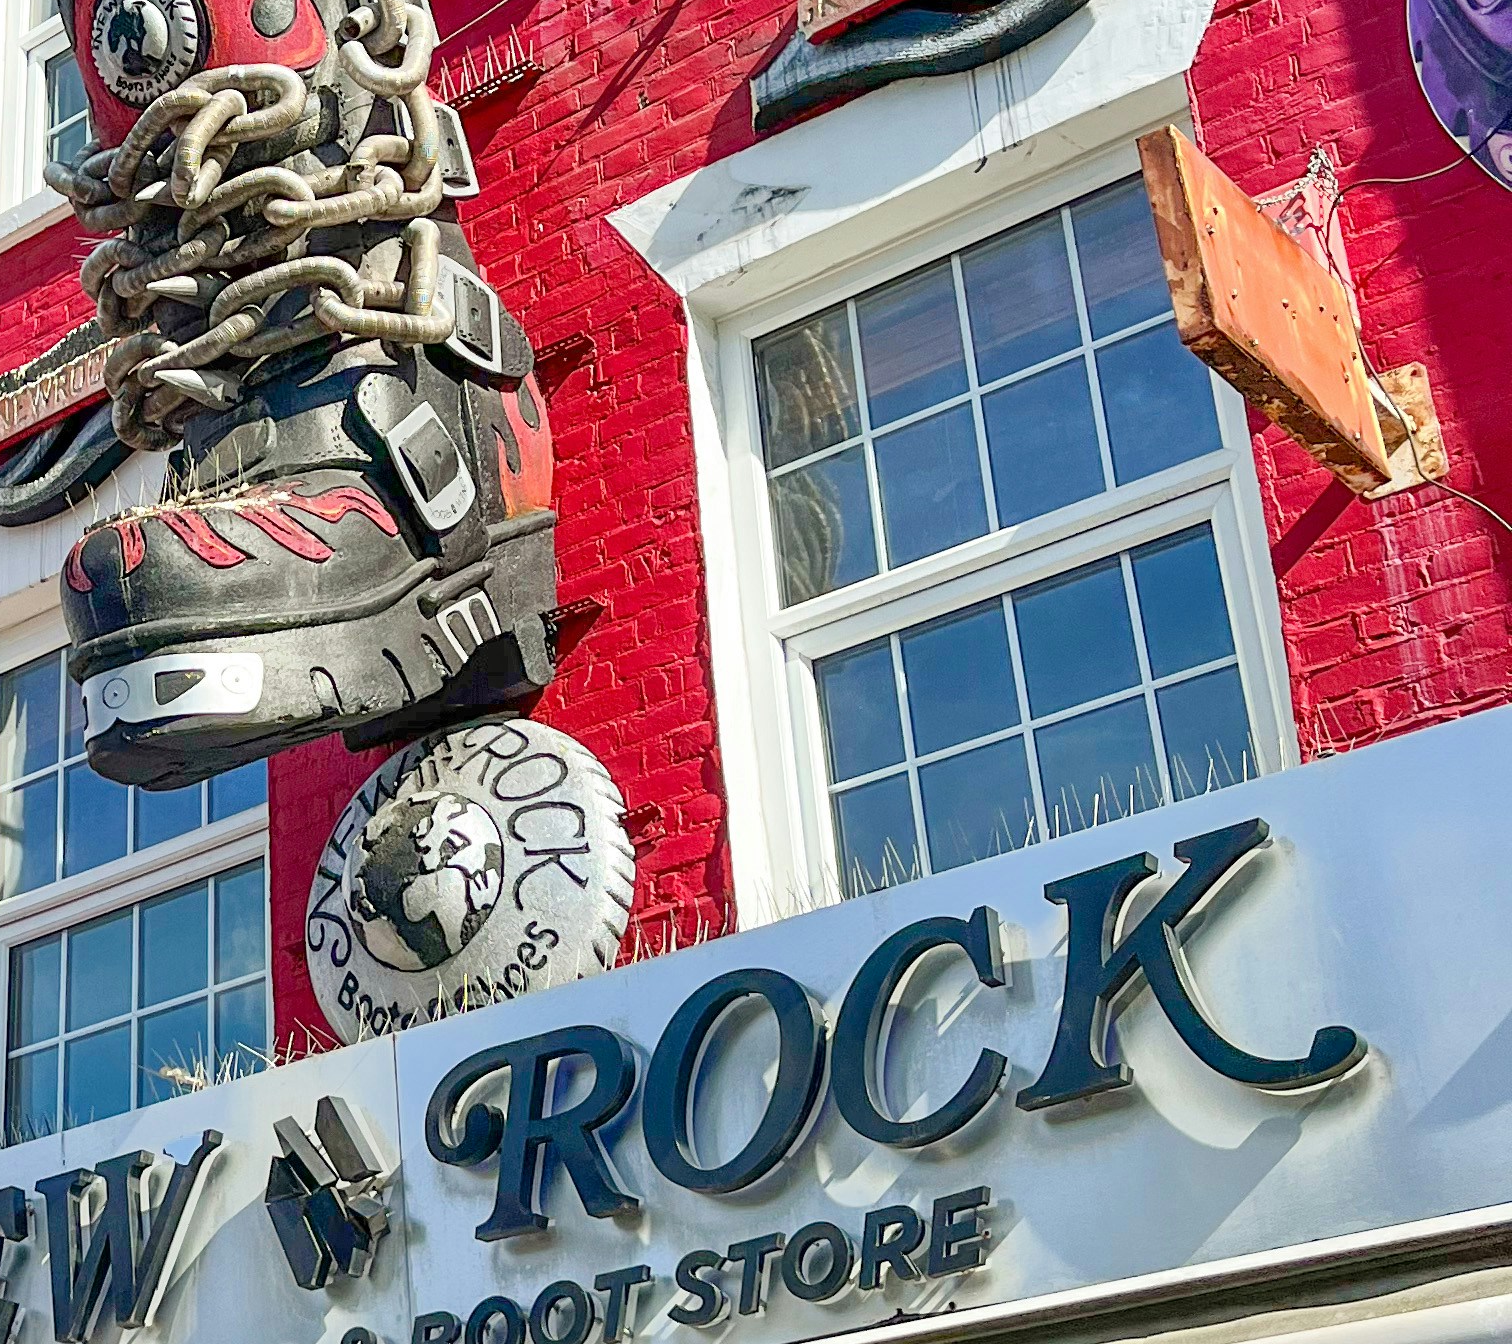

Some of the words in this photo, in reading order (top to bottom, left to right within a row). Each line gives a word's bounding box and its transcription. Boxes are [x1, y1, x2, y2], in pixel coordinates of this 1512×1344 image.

[307, 750, 423, 967] NEW
[454, 722, 591, 912] ROCK
[424, 816, 1370, 1242] ROCK
[667, 1185, 993, 1326] STORE
